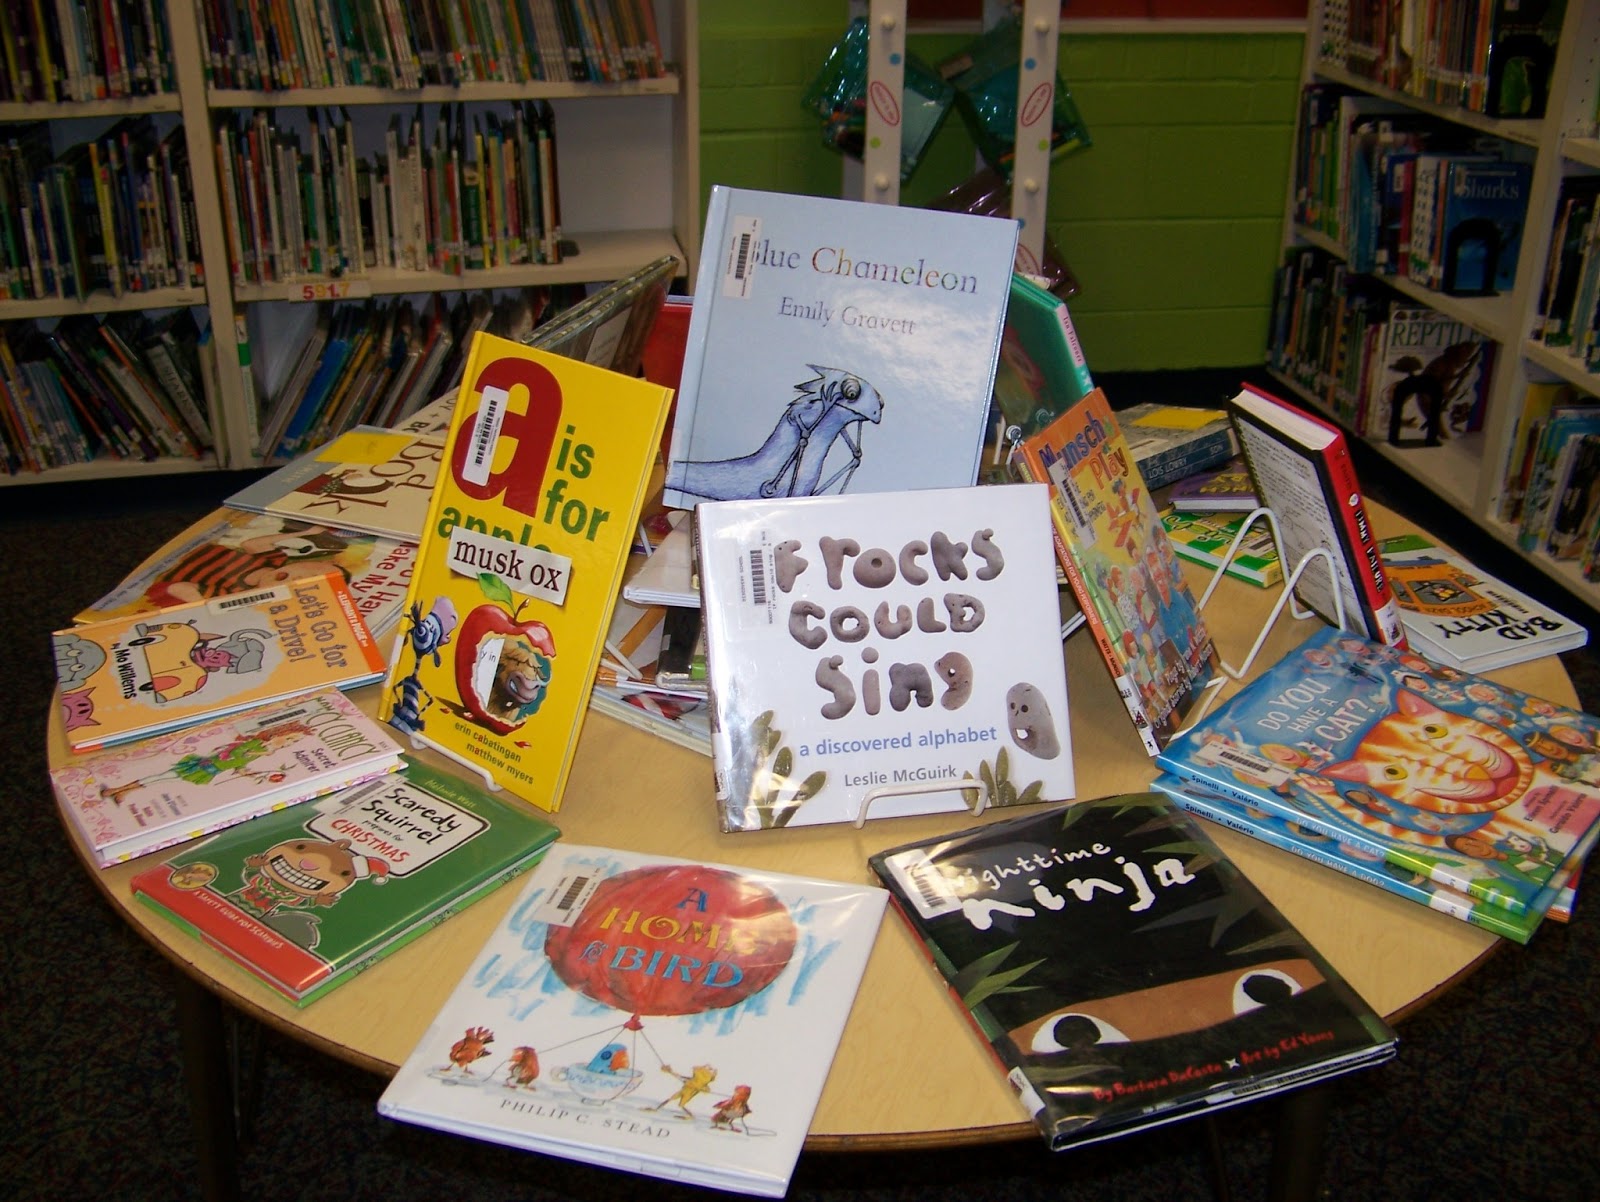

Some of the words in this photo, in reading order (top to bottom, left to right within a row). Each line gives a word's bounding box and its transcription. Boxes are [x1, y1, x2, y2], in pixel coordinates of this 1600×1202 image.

[754, 239, 800, 270] lue
[811, 247, 978, 294] Chameleon
[303, 282, 350, 300] 591.7
[778, 295, 835, 328] Emily
[842, 306, 917, 335] Gravett
[556, 425, 595, 479] is
[1150, 466, 1164, 479] LOIS
[1165, 458, 1187, 473] LOWRY
[544, 479, 610, 542] for
[454, 539, 523, 581] musk
[530, 563, 562, 591] ox
[1355, 510, 1370, 544] TIMMY
[1367, 546, 1384, 593] FAILURE
[294, 584, 329, 618] Let's
[352, 574, 388, 593] My
[270, 604, 288, 614] a
[359, 591, 400, 617] Hav
[789, 592, 985, 650] COULD
[274, 615, 316, 663] Drive!
[311, 621, 338, 642] Go
[1430, 609, 1518, 639] KITTY
[1497, 616, 1563, 640] BAD
[113, 648, 128, 663] Mo
[321, 644, 348, 668] for
[117, 662, 138, 699] Willems
[1268, 678, 1332, 710] YOU
[1257, 711, 1291, 731] DO
[1287, 706, 1327, 733] HAVE
[1322, 698, 1339, 707] A
[1314, 698, 1377, 742] CAT?
[311, 748, 338, 768] Secret
[454, 721, 472, 739] erin
[473, 731, 522, 763] cabatingan
[800, 743, 810, 757] a
[816, 732, 913, 756] discovered
[919, 726, 997, 749] alphabet
[466, 741, 505, 770] matthew
[506, 763, 534, 785] myers
[844, 769, 888, 787] Leslie
[893, 764, 957, 783] McGuirk
[1191, 774, 1219, 791] Spinelli
[1232, 790, 1259, 807] Valério
[361, 800, 443, 845] Squirrel
[385, 788, 462, 832] Scaredy
[1185, 803, 1214, 820] Spinelli
[1226, 819, 1254, 836] Valério
[331, 819, 410, 863] CHRISTMAS
[676, 887, 709, 912] A
[963, 856, 1195, 930] ninja
[600, 907, 759, 955] HOME
[610, 945, 744, 988] BIRD
[500, 1098, 570, 1119] PHILIP
[576, 1112, 594, 1126] C.
[603, 1118, 671, 1138] STEAD
